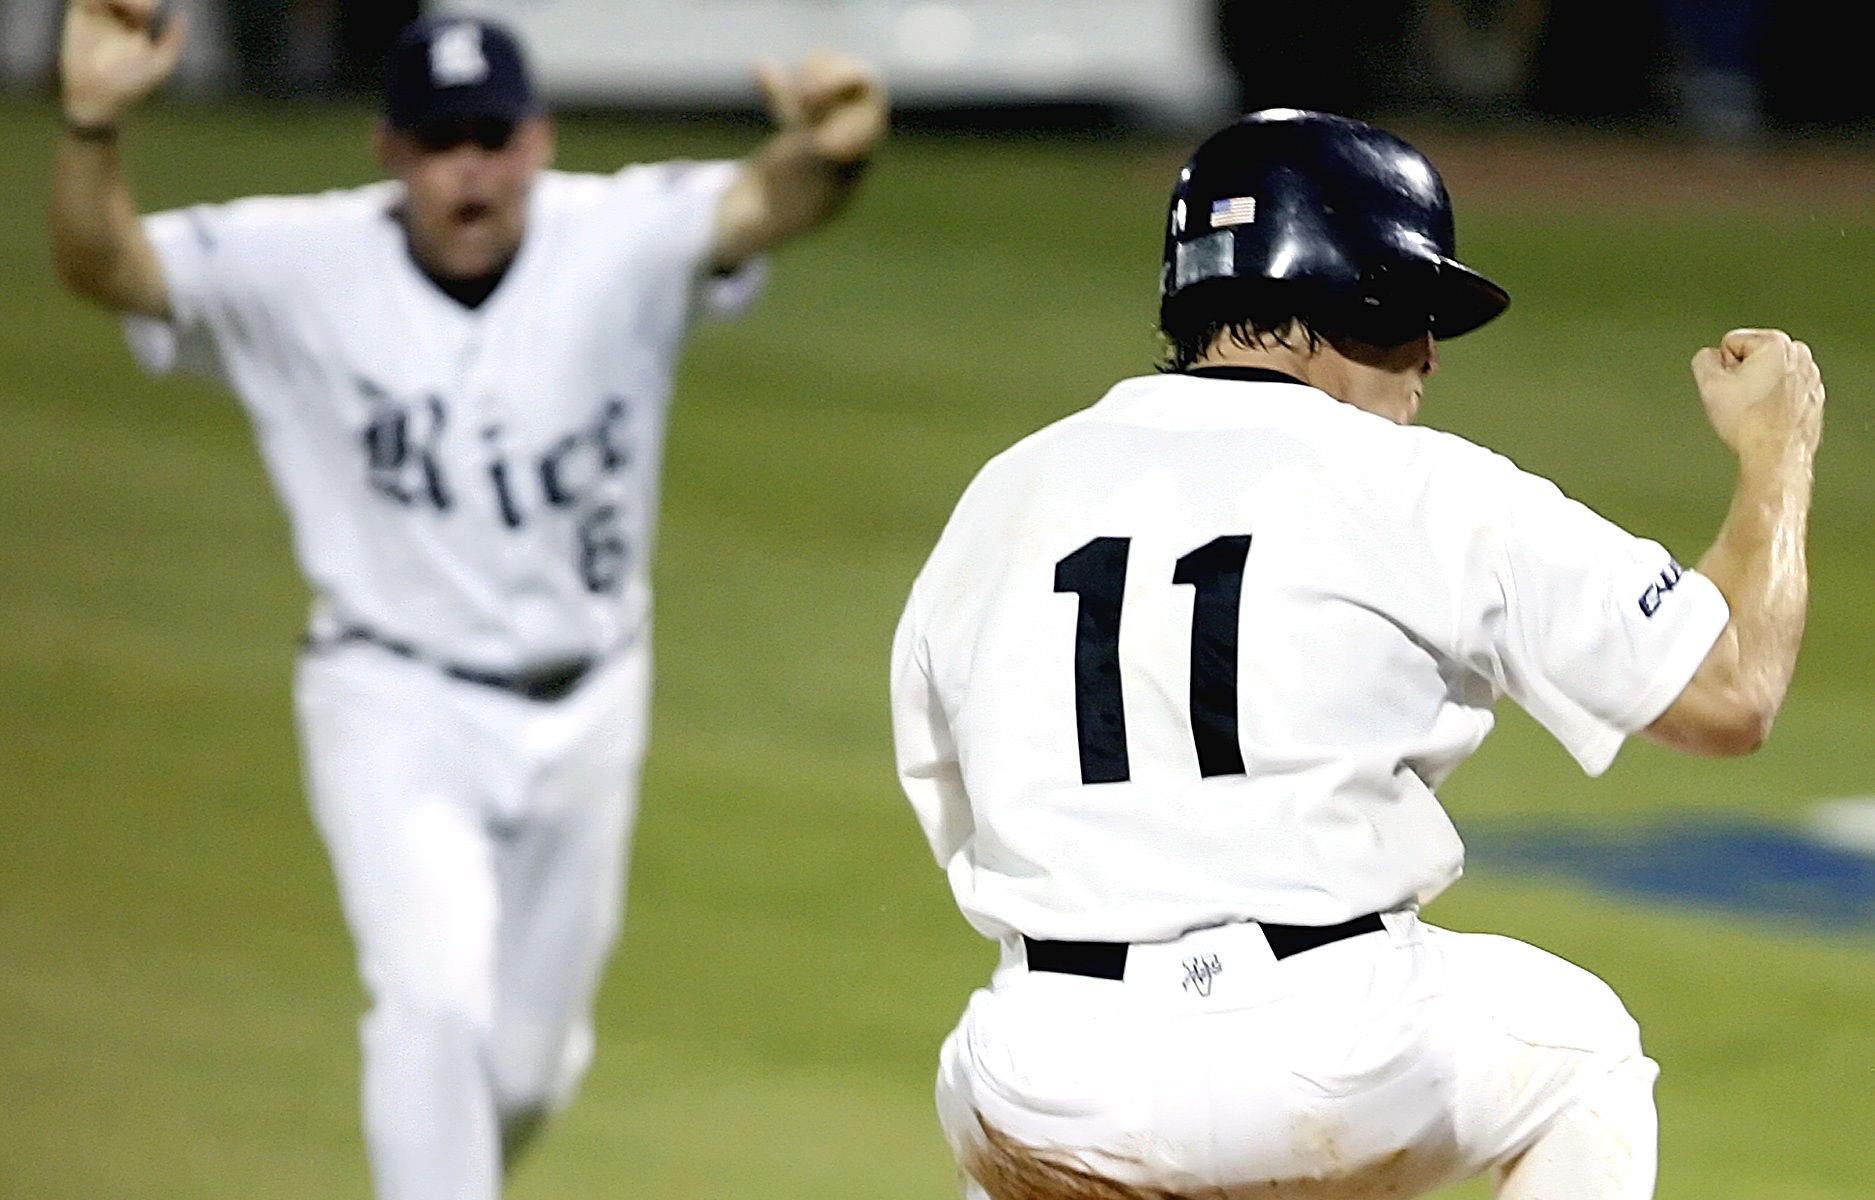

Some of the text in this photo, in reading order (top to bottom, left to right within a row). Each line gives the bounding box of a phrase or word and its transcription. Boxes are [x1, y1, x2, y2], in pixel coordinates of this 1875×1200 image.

[354, 376, 628, 528] Rice
[577, 503, 627, 593] 6
[1053, 533, 1252, 784] 11
